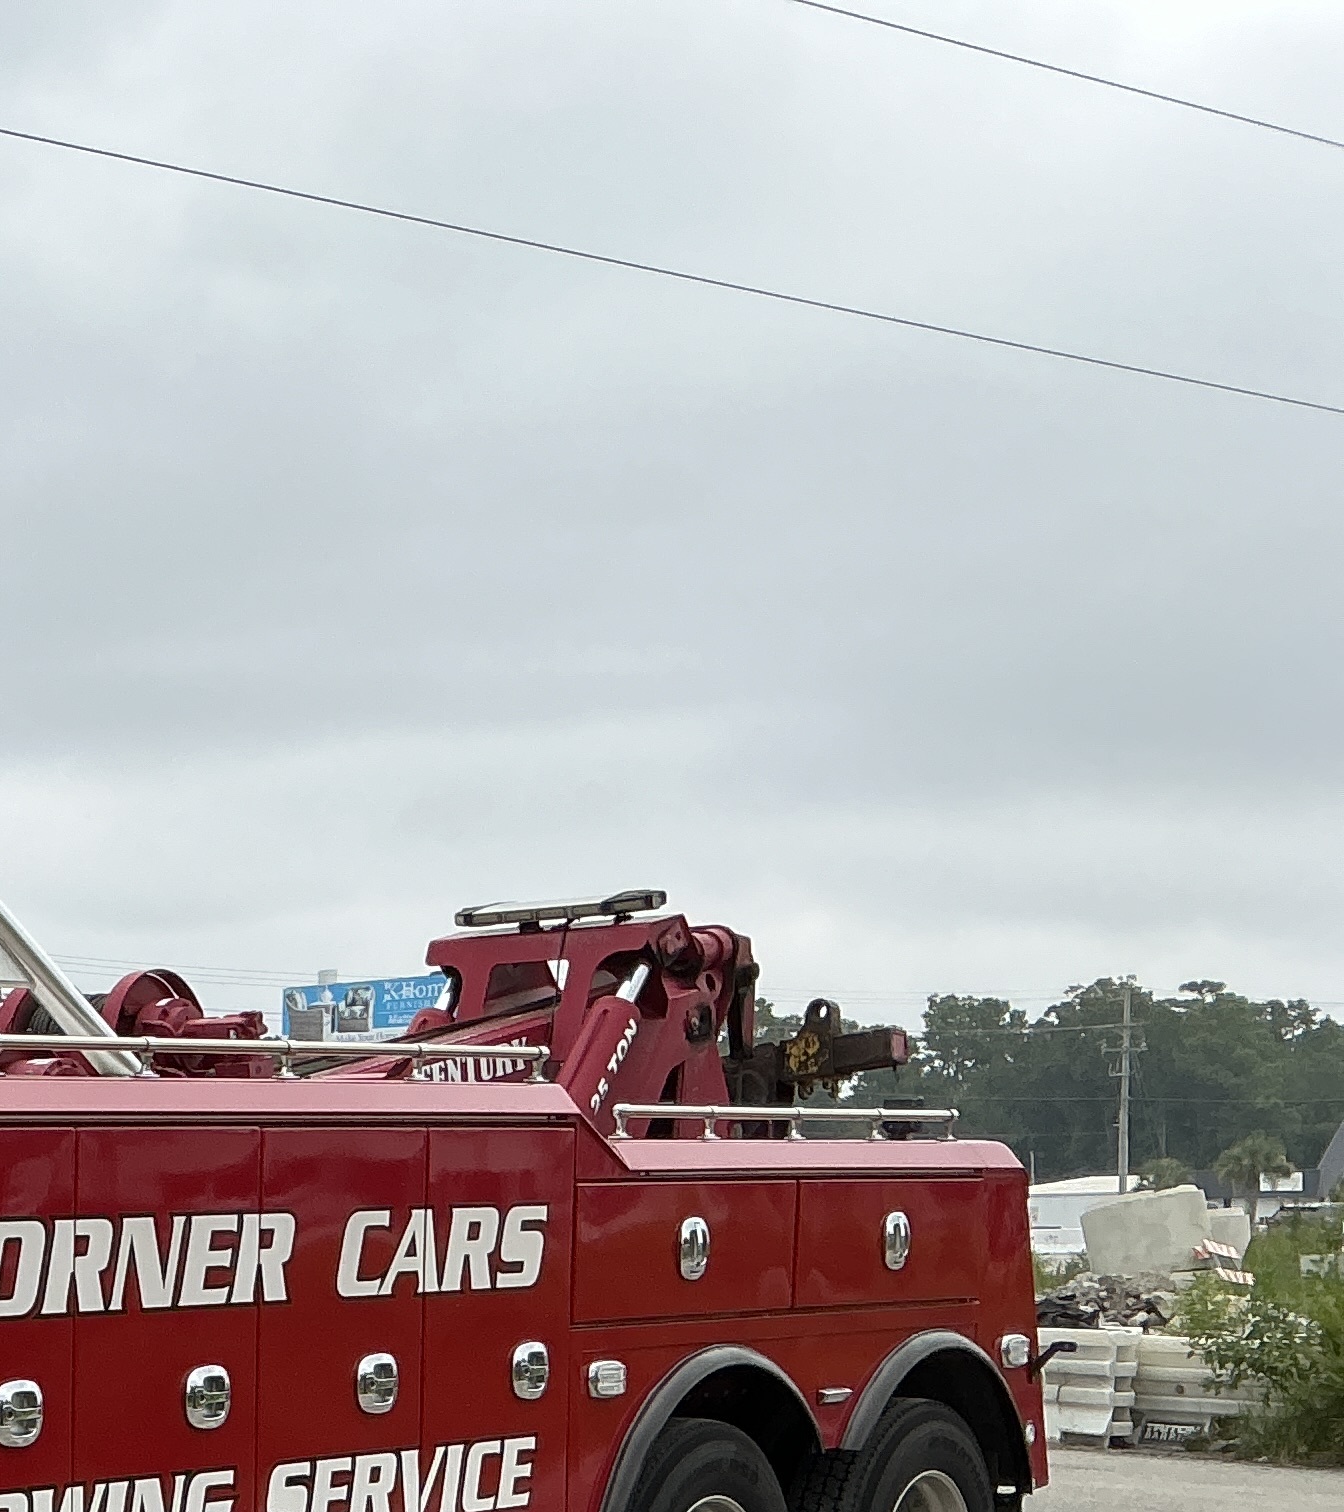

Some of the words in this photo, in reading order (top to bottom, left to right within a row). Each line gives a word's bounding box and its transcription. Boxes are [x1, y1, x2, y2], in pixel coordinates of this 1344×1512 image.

[590, 1076, 609, 1116] 25
[606, 1018, 638, 1075] TON
[336, 1204, 549, 1299] CARS
